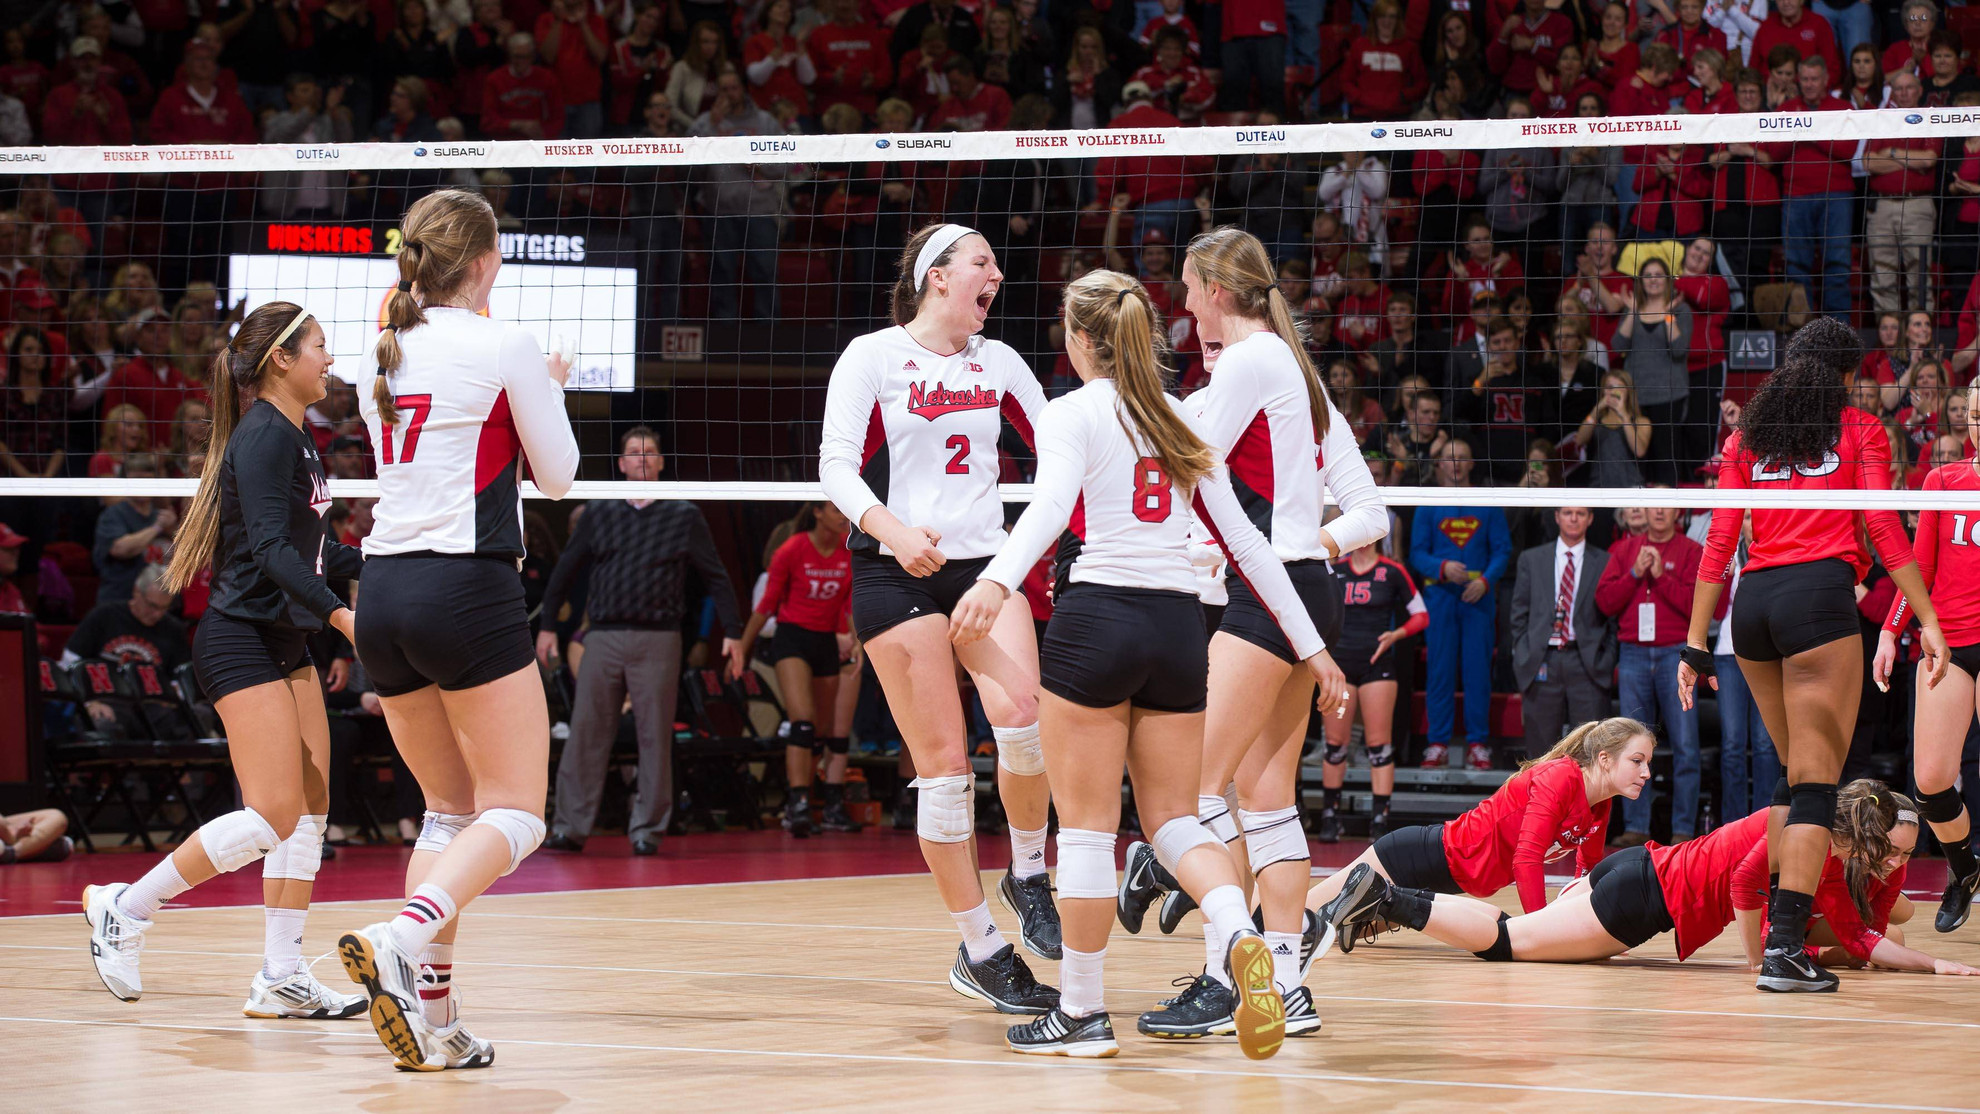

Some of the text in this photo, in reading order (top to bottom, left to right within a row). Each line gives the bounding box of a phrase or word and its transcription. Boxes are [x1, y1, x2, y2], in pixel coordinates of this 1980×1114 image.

[1521, 120, 1682, 136] HUSKER VOLLEYBALL
[1759, 117, 1812, 129] DUTEAU
[1015, 133, 1165, 147] HUSKER VOLLEYBALL
[1236, 130, 1286, 142] DUTEAU
[1394, 127, 1453, 138] SUBARU
[544, 143, 684, 156] HUSKER VOLLEYBALL
[750, 141, 796, 152] DUTEAU
[897, 139, 951, 149] SUBARU
[0, 153, 47, 162] SUBARU
[103, 150, 235, 162] HUSKER VOLLEYBALL
[296, 149, 340, 159] DUTEAU
[433, 148, 486, 157] SUBARU
[267, 223, 373, 253] HUSKERS
[498, 232, 585, 262] UTGERS
[1736, 337, 1770, 358] A3
[907, 380, 1000, 413] Nebraska
[1493, 393, 1525, 422] N
[381, 393, 432, 465] 17
[945, 434, 971, 474] 2
[1132, 456, 1172, 523] 8
[1344, 581, 1372, 605] 15
[86, 663, 115, 693] N
[137, 665, 163, 695] N
